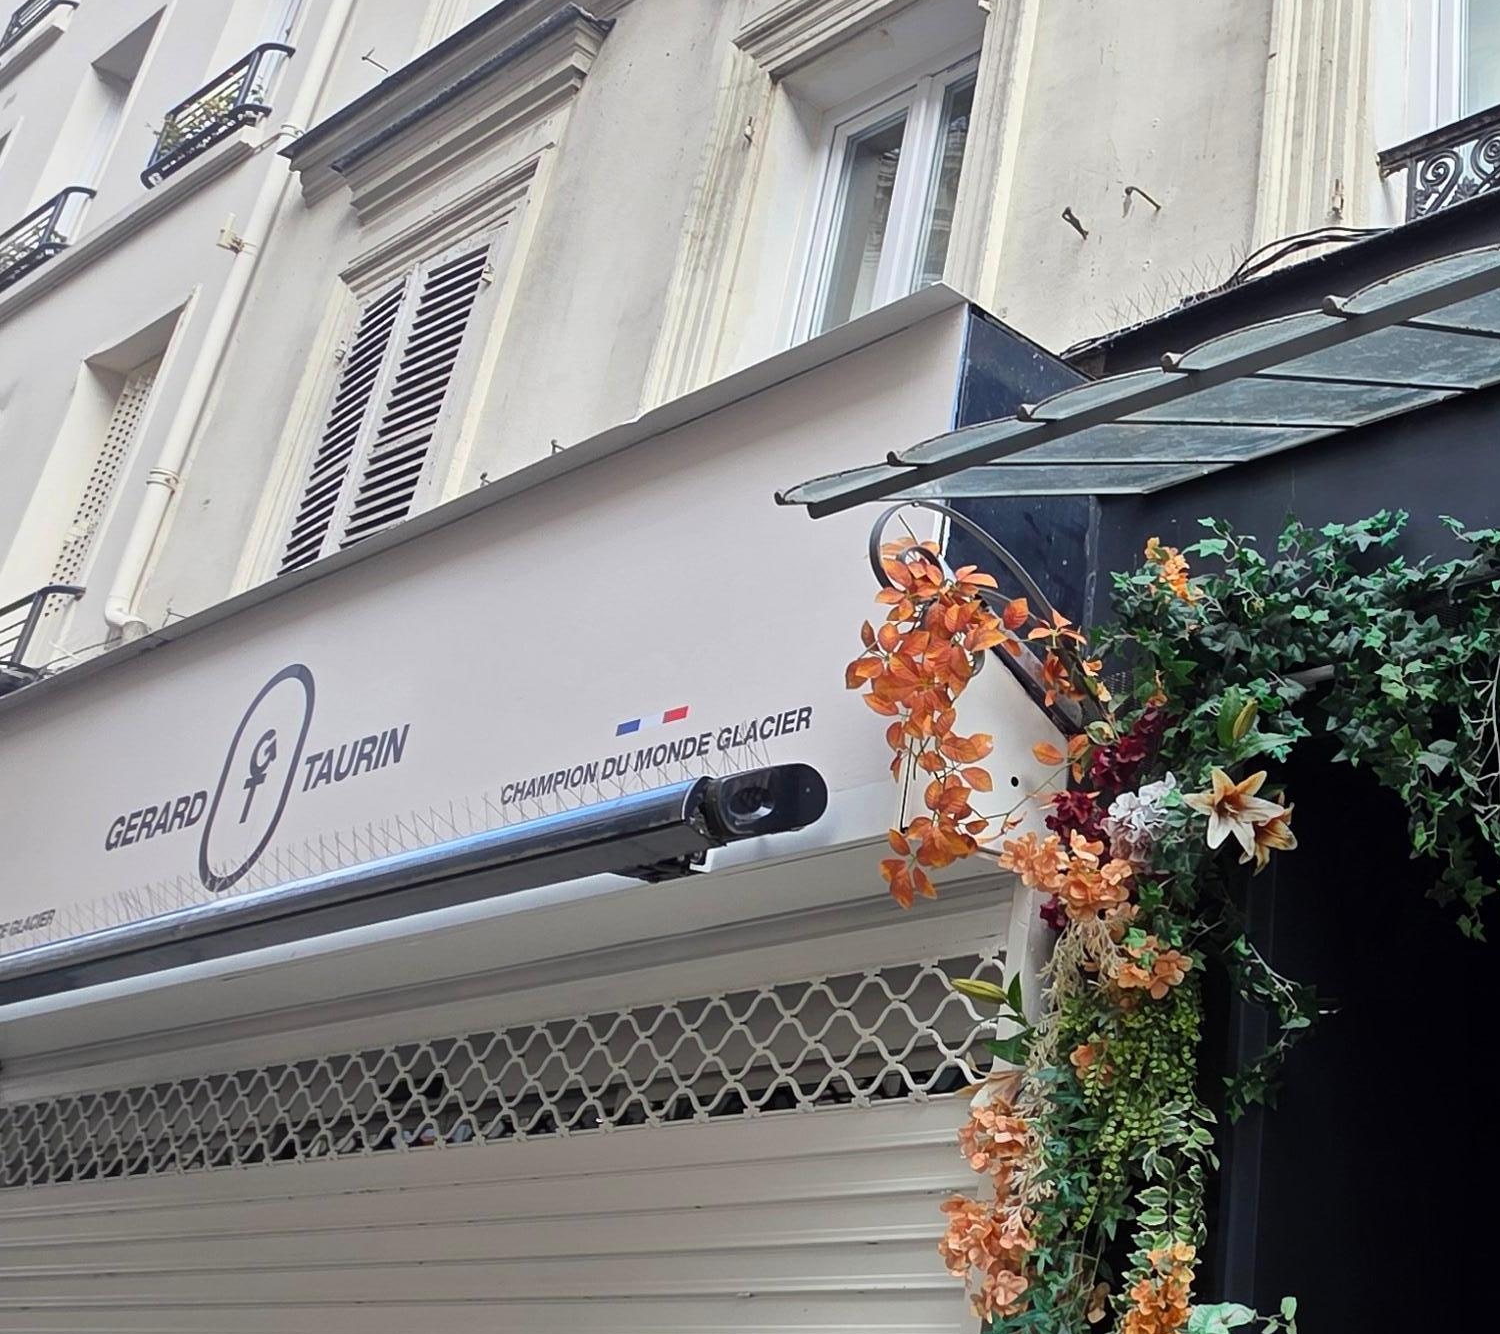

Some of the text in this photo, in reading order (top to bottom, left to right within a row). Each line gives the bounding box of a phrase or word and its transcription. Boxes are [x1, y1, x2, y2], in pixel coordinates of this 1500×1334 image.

[105, 724, 410, 851] GERARD TAURIN
[500, 706, 813, 805] CHAMPION DU MONDE GLACIER
[9, 909, 56, 936] GLACIER
